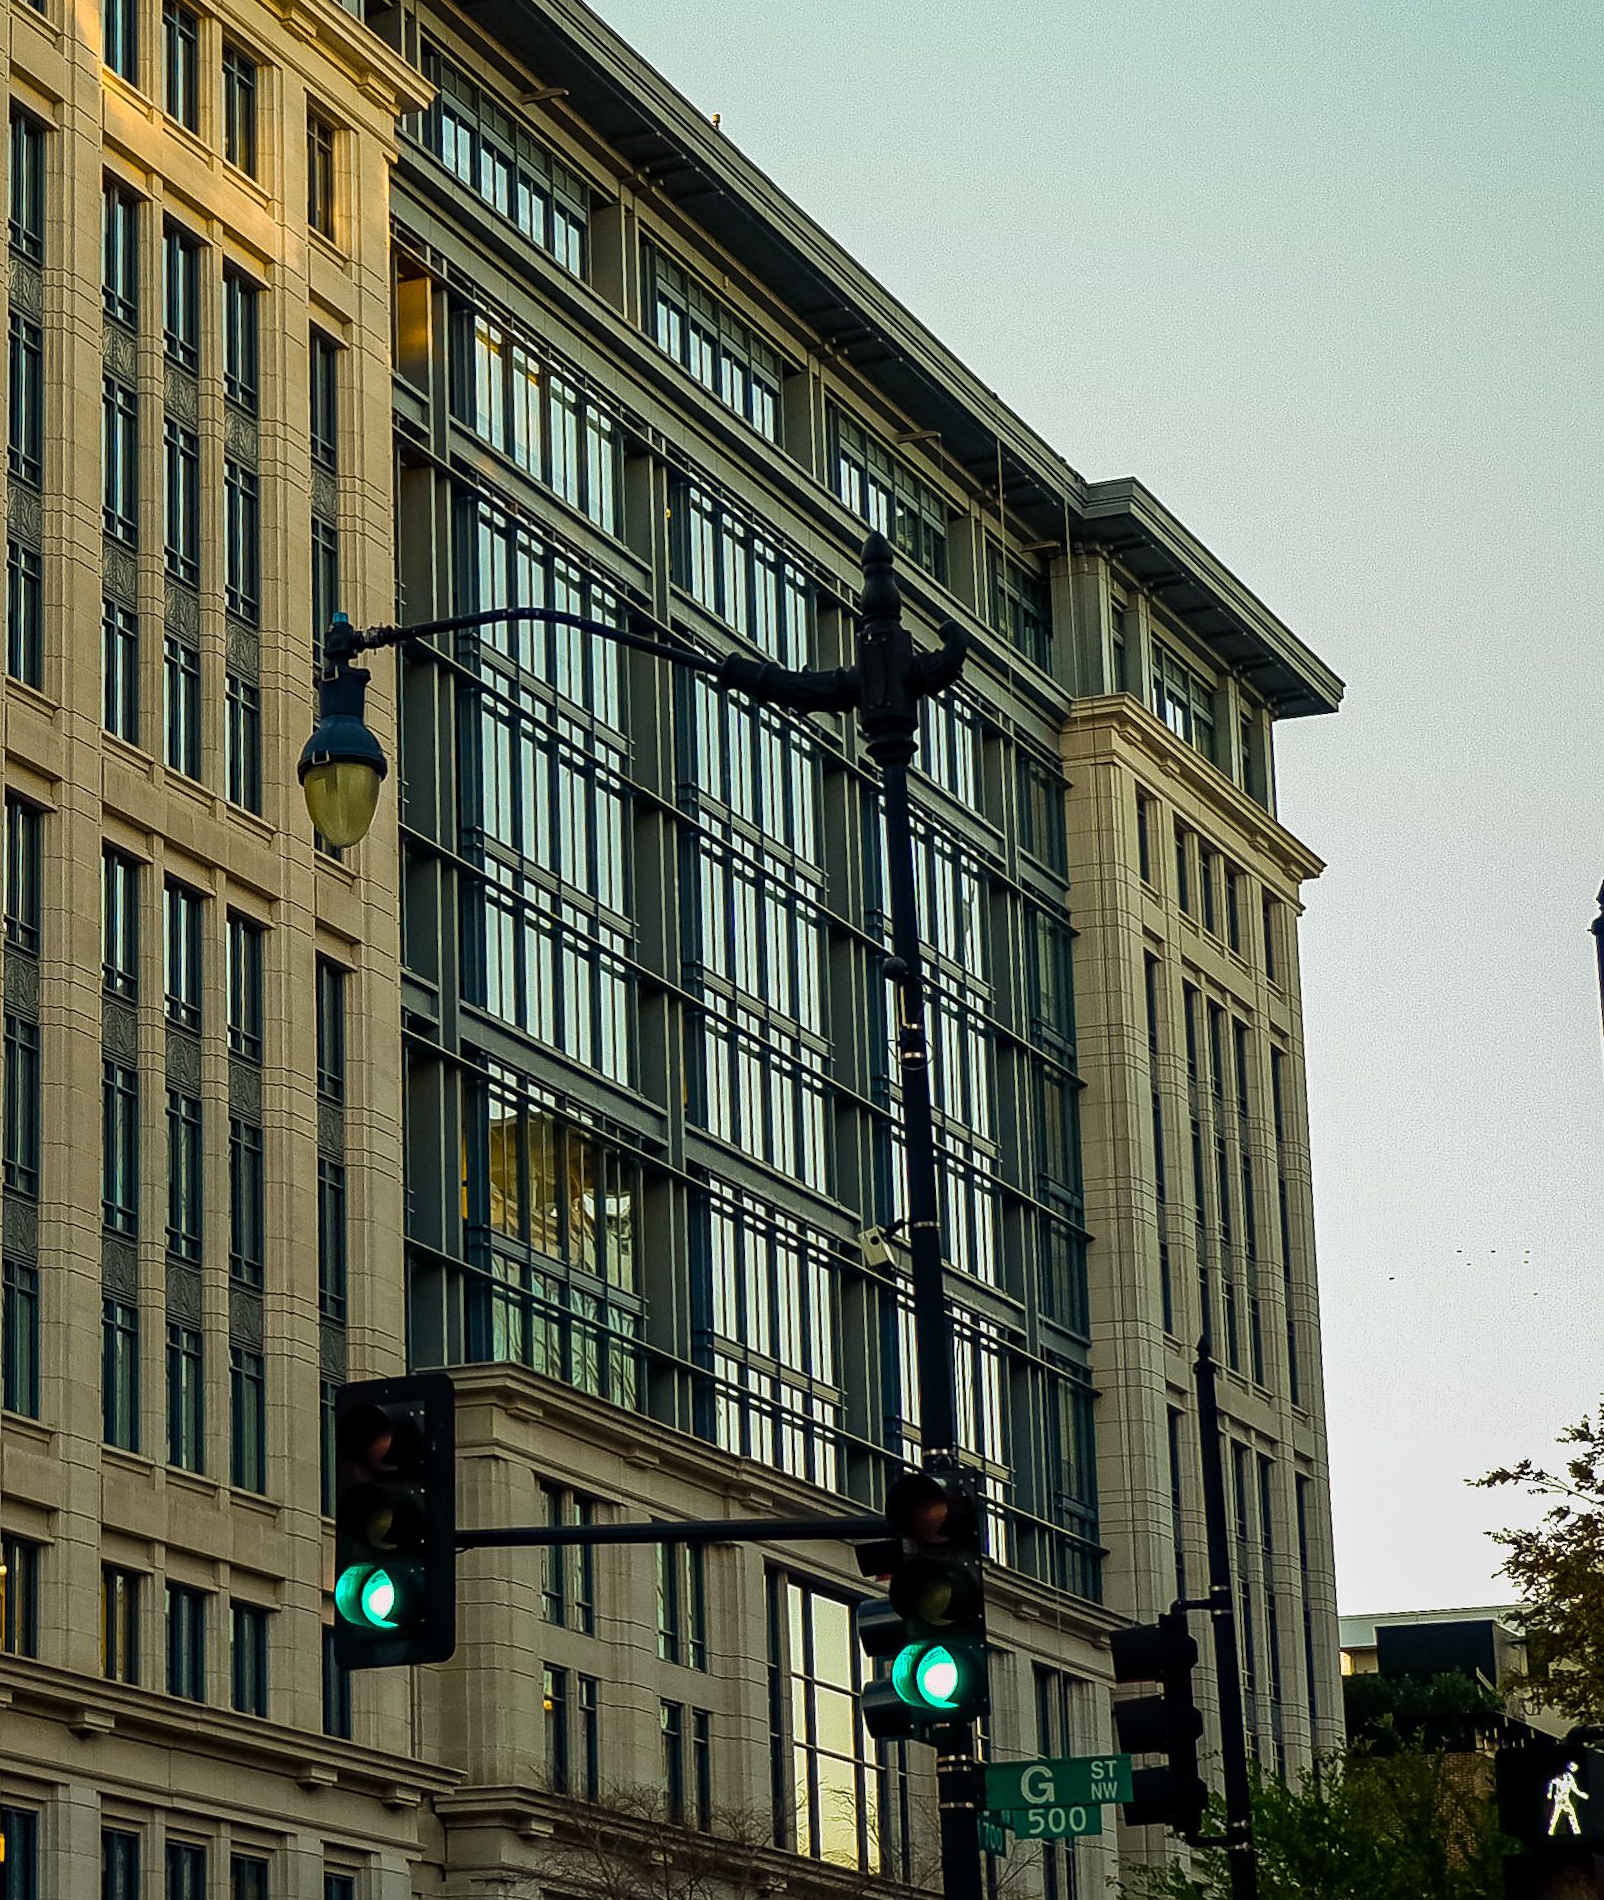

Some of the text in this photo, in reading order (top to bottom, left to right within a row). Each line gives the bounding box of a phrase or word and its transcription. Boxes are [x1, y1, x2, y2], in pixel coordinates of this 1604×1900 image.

[1020, 1760, 1117, 1805] G ST
[1091, 1780, 1118, 1800] NW
[1028, 1806, 1087, 1834] 500
[983, 1820, 1003, 1852] 700
